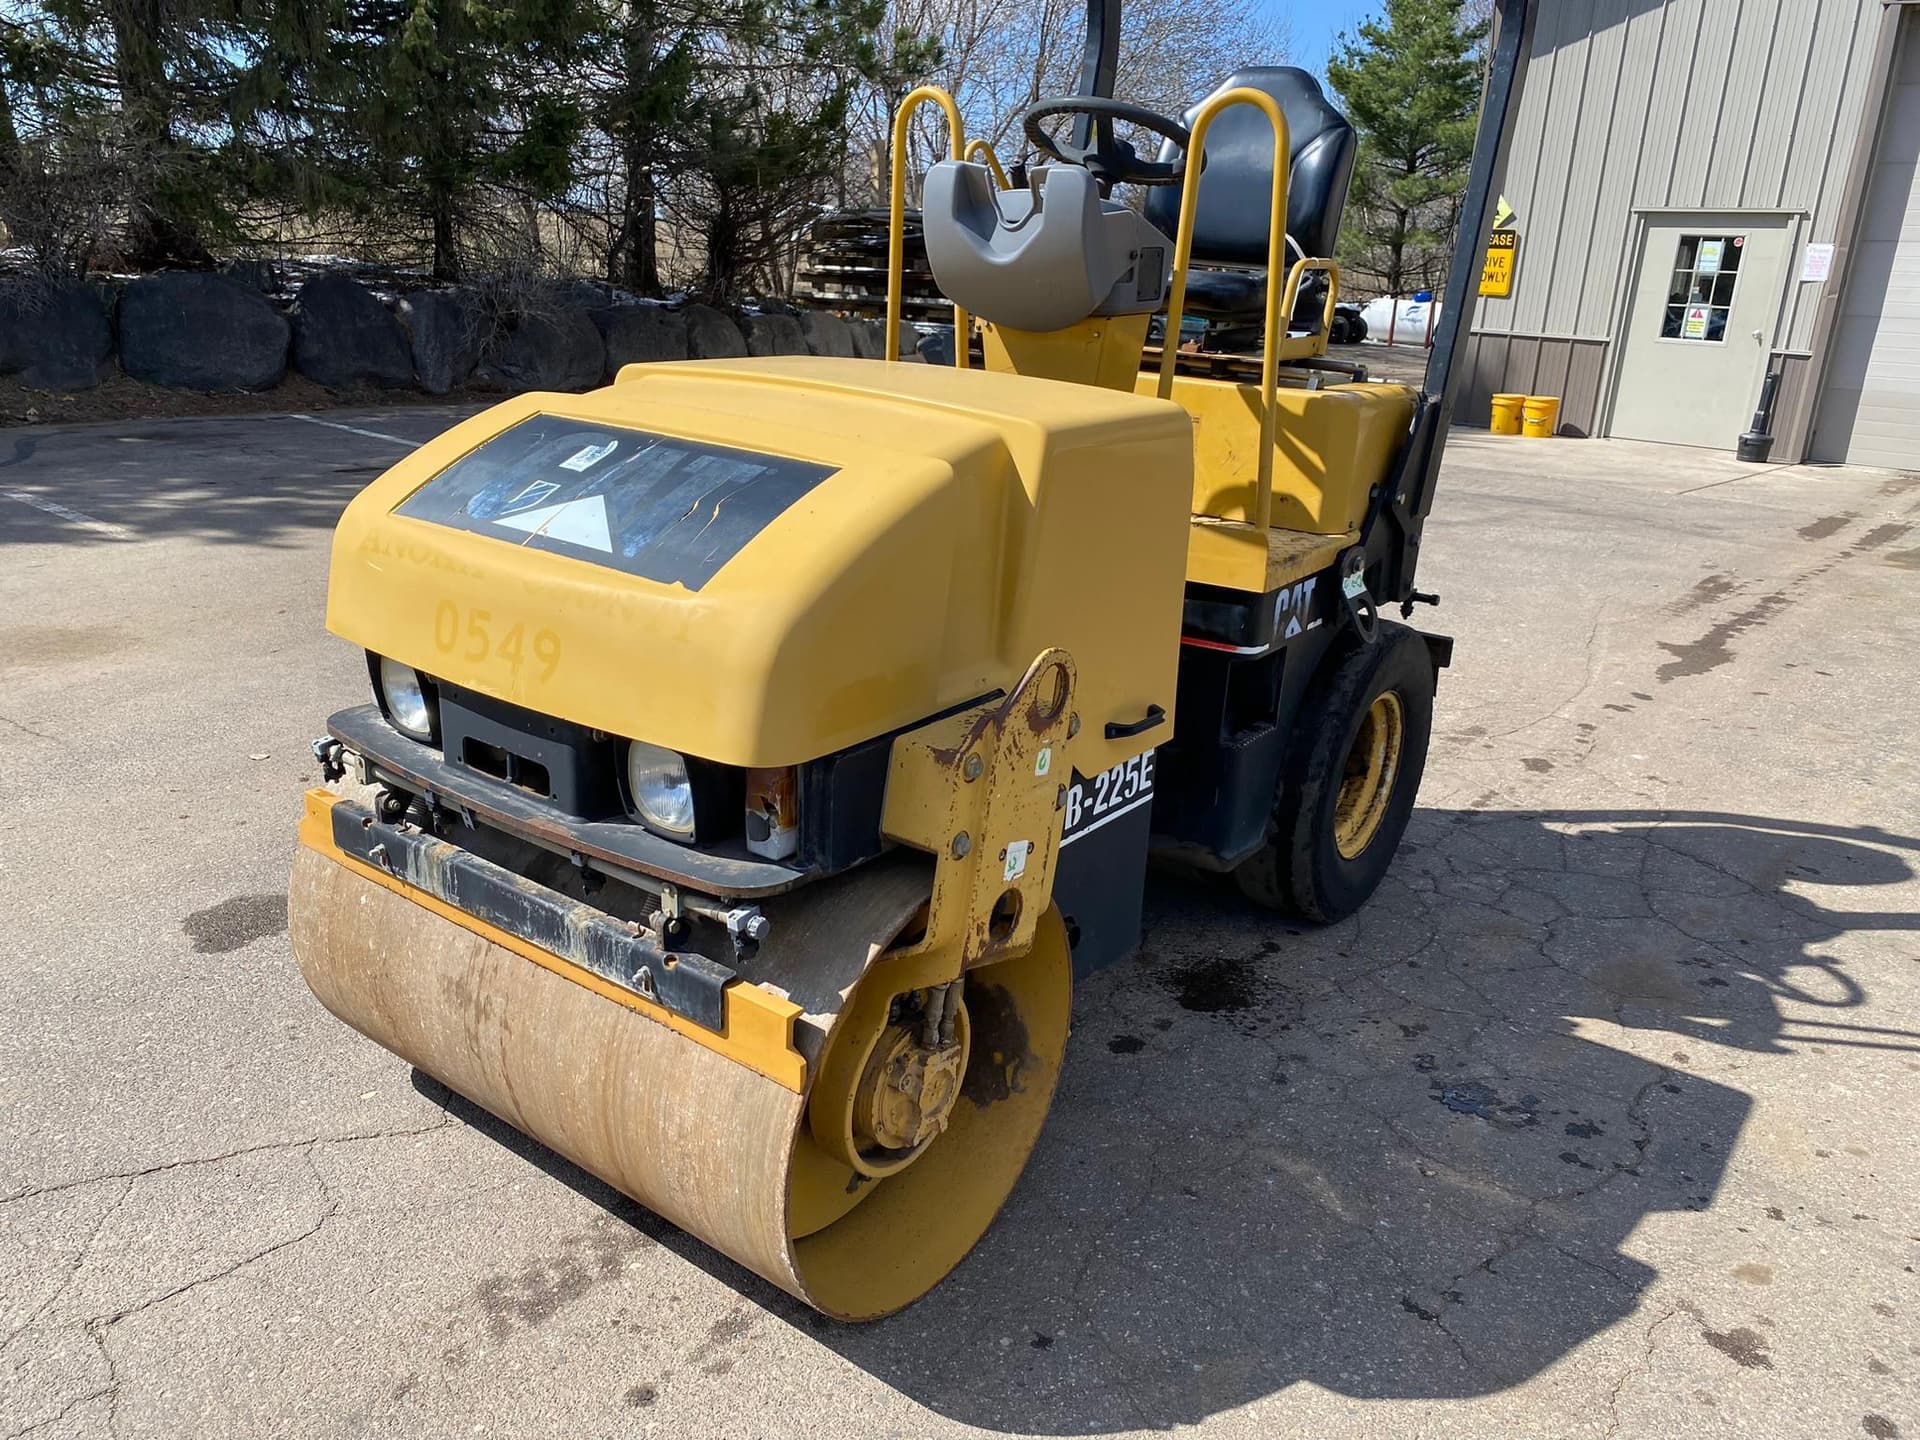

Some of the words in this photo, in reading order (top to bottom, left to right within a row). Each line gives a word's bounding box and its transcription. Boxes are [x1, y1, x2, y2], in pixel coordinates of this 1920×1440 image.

[1489, 234, 1513, 246] EASE
[1484, 256, 1505, 268] RIVE
[1481, 271, 1507, 283] OWLY
[1273, 576, 1318, 639] CAT
[434, 600, 562, 684] 0549
